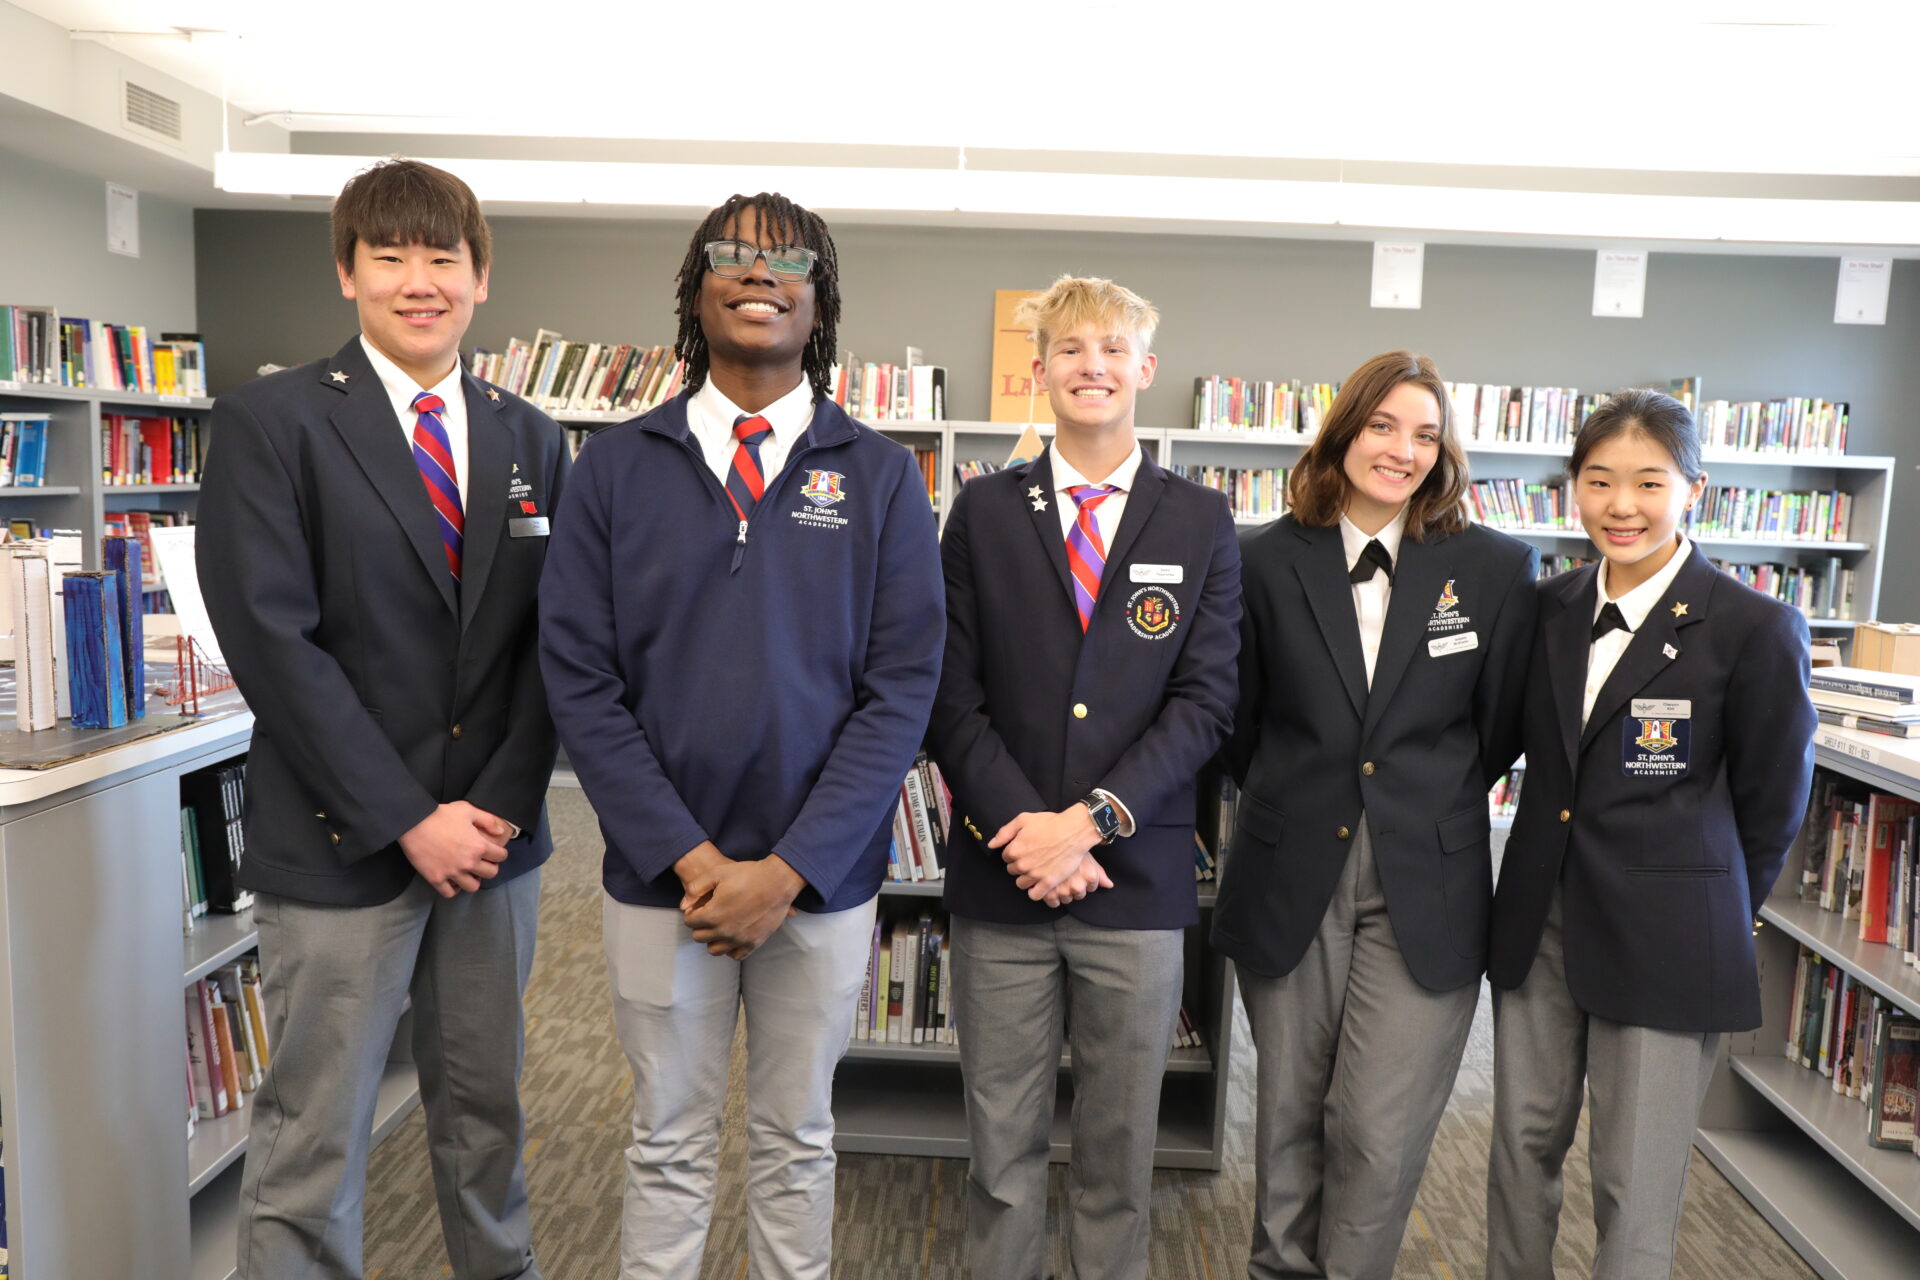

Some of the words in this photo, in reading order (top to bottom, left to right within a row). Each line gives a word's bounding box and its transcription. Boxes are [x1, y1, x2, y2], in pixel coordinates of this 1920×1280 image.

[791, 511, 848, 525] NORTHWESTERN
[814, 507, 838, 516] JOHN'S
[798, 520, 839, 529] ACADEMIES
[1130, 587, 1148, 602] JOHN'S
[1147, 586, 1180, 615] NORTHWESTERN
[1438, 610, 1459, 619] JOHN'S
[1126, 616, 1154, 640] LEADERSHIP
[1154, 621, 1178, 640] ACADEMY
[1824, 735, 1837, 748] SHELF
[1625, 761, 1687, 769] NORTHWESTERN
[1649, 754, 1675, 763] JOHN'S
[907, 776, 917, 791] THE
[909, 791, 920, 808] TIME
[916, 818, 927, 842] STALIN
